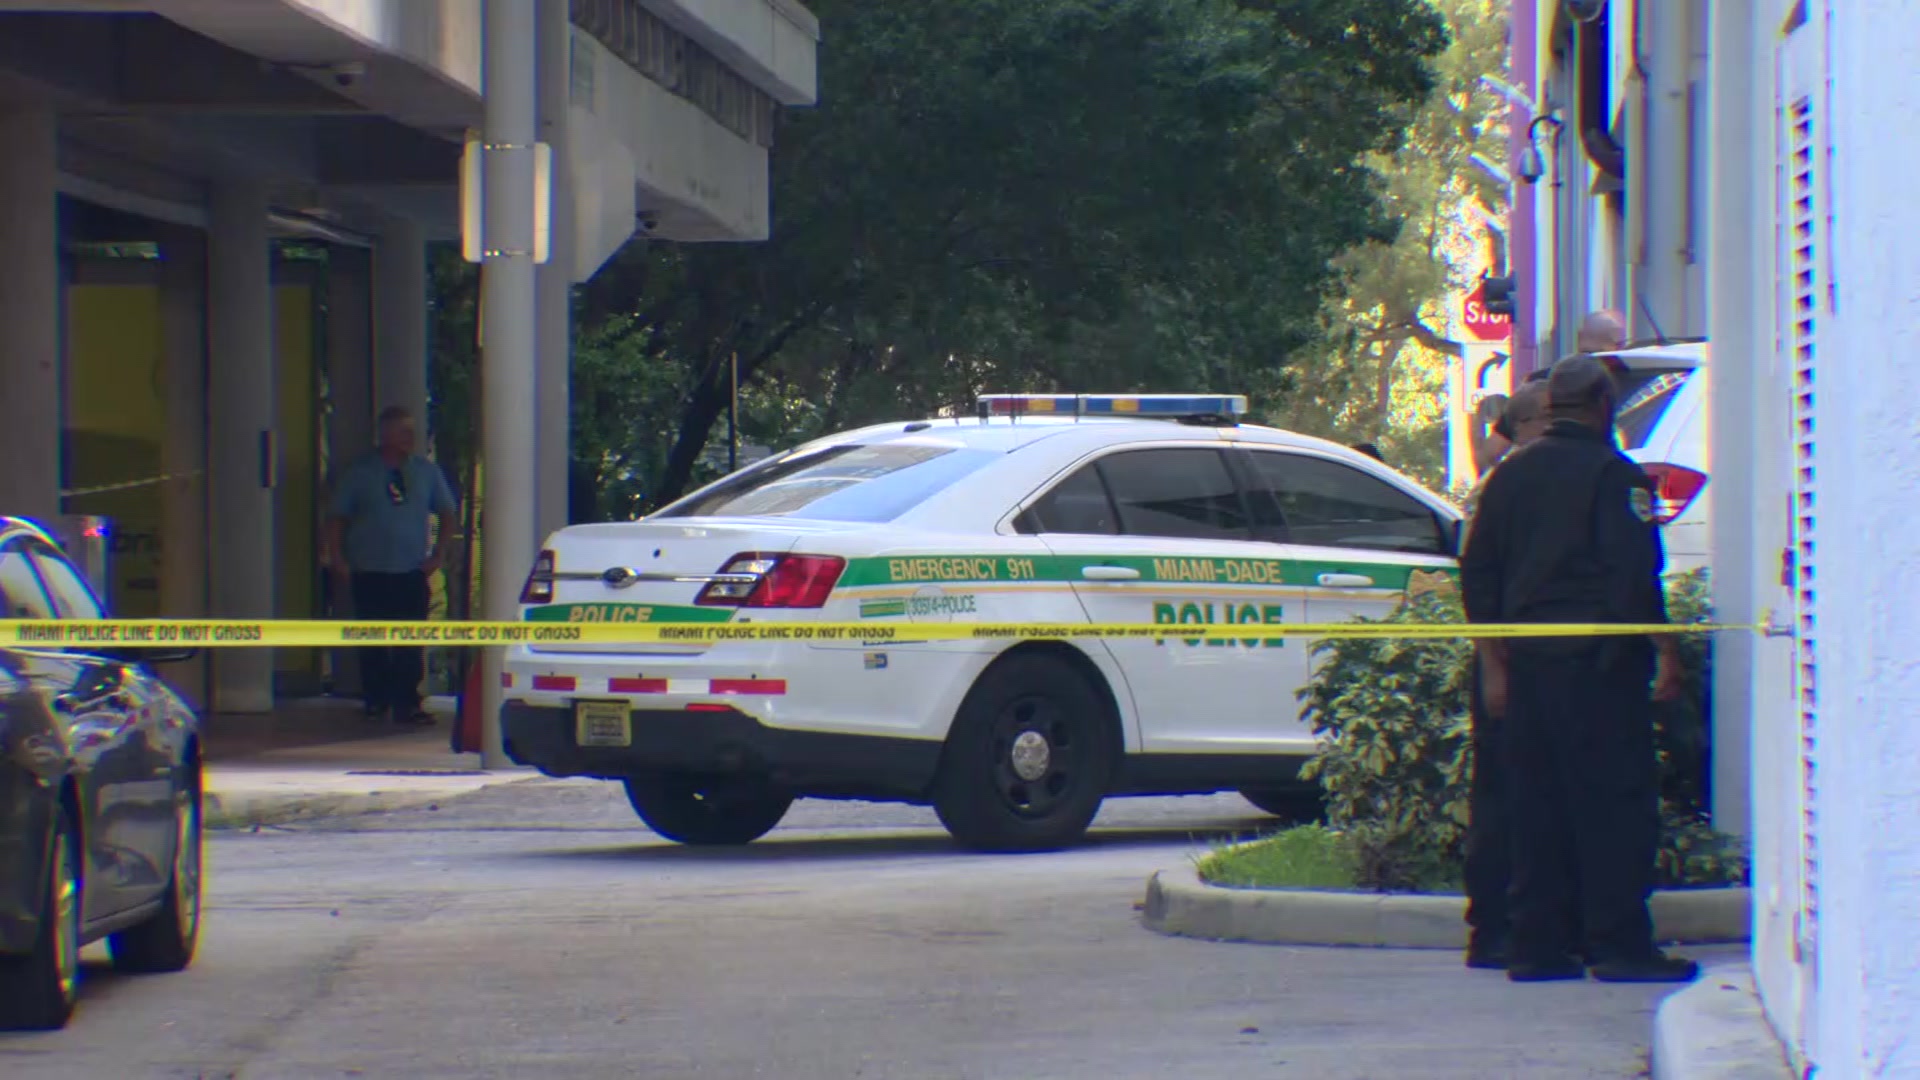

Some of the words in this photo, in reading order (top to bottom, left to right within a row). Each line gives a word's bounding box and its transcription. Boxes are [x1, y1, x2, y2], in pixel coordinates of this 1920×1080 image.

[889, 559, 997, 581] EMERGENCY
[1007, 558, 1034, 579] 911
[1153, 558, 1282, 583] MIAMI-DADE
[569, 605, 653, 624] POLICE
[1152, 601, 1284, 648] POLICE
[19, 624, 64, 641] MIAMI
[68, 624, 118, 641] POLICE
[123, 624, 154, 641] LINE
[159, 624, 177, 641] DO
[182, 624, 209, 641] NOT
[214, 624, 261, 641] CROSS
[342, 626, 386, 640] MIAMI
[391, 626, 439, 640] POLICE
[443, 626, 474, 640] LINE
[478, 626, 497, 640] DO
[502, 626, 529, 640] NOT
